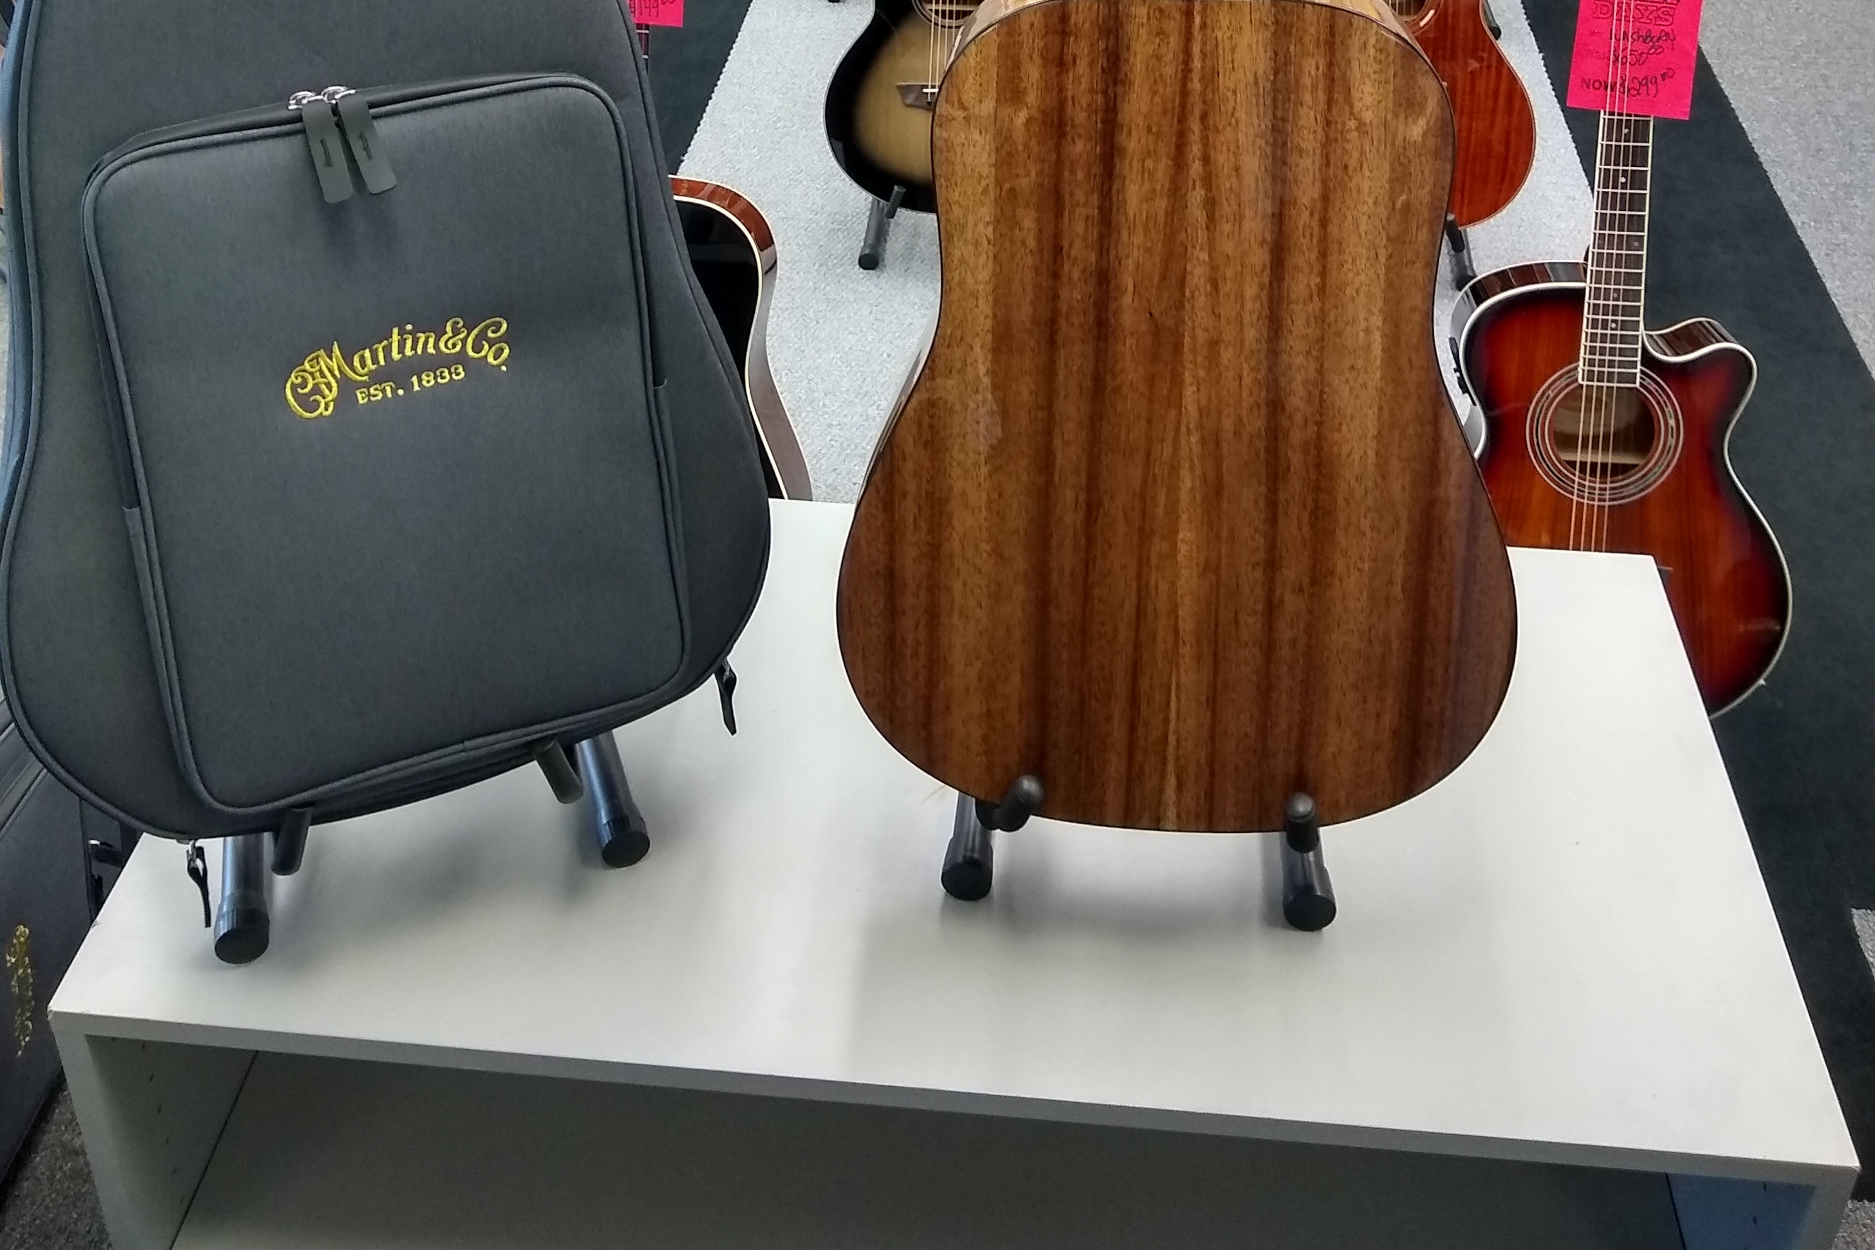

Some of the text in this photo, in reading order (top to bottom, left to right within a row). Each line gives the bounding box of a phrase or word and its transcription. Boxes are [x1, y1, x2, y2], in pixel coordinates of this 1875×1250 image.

[1580, 77, 1617, 93] NOW
[355, 363, 466, 405] EST. 1833
